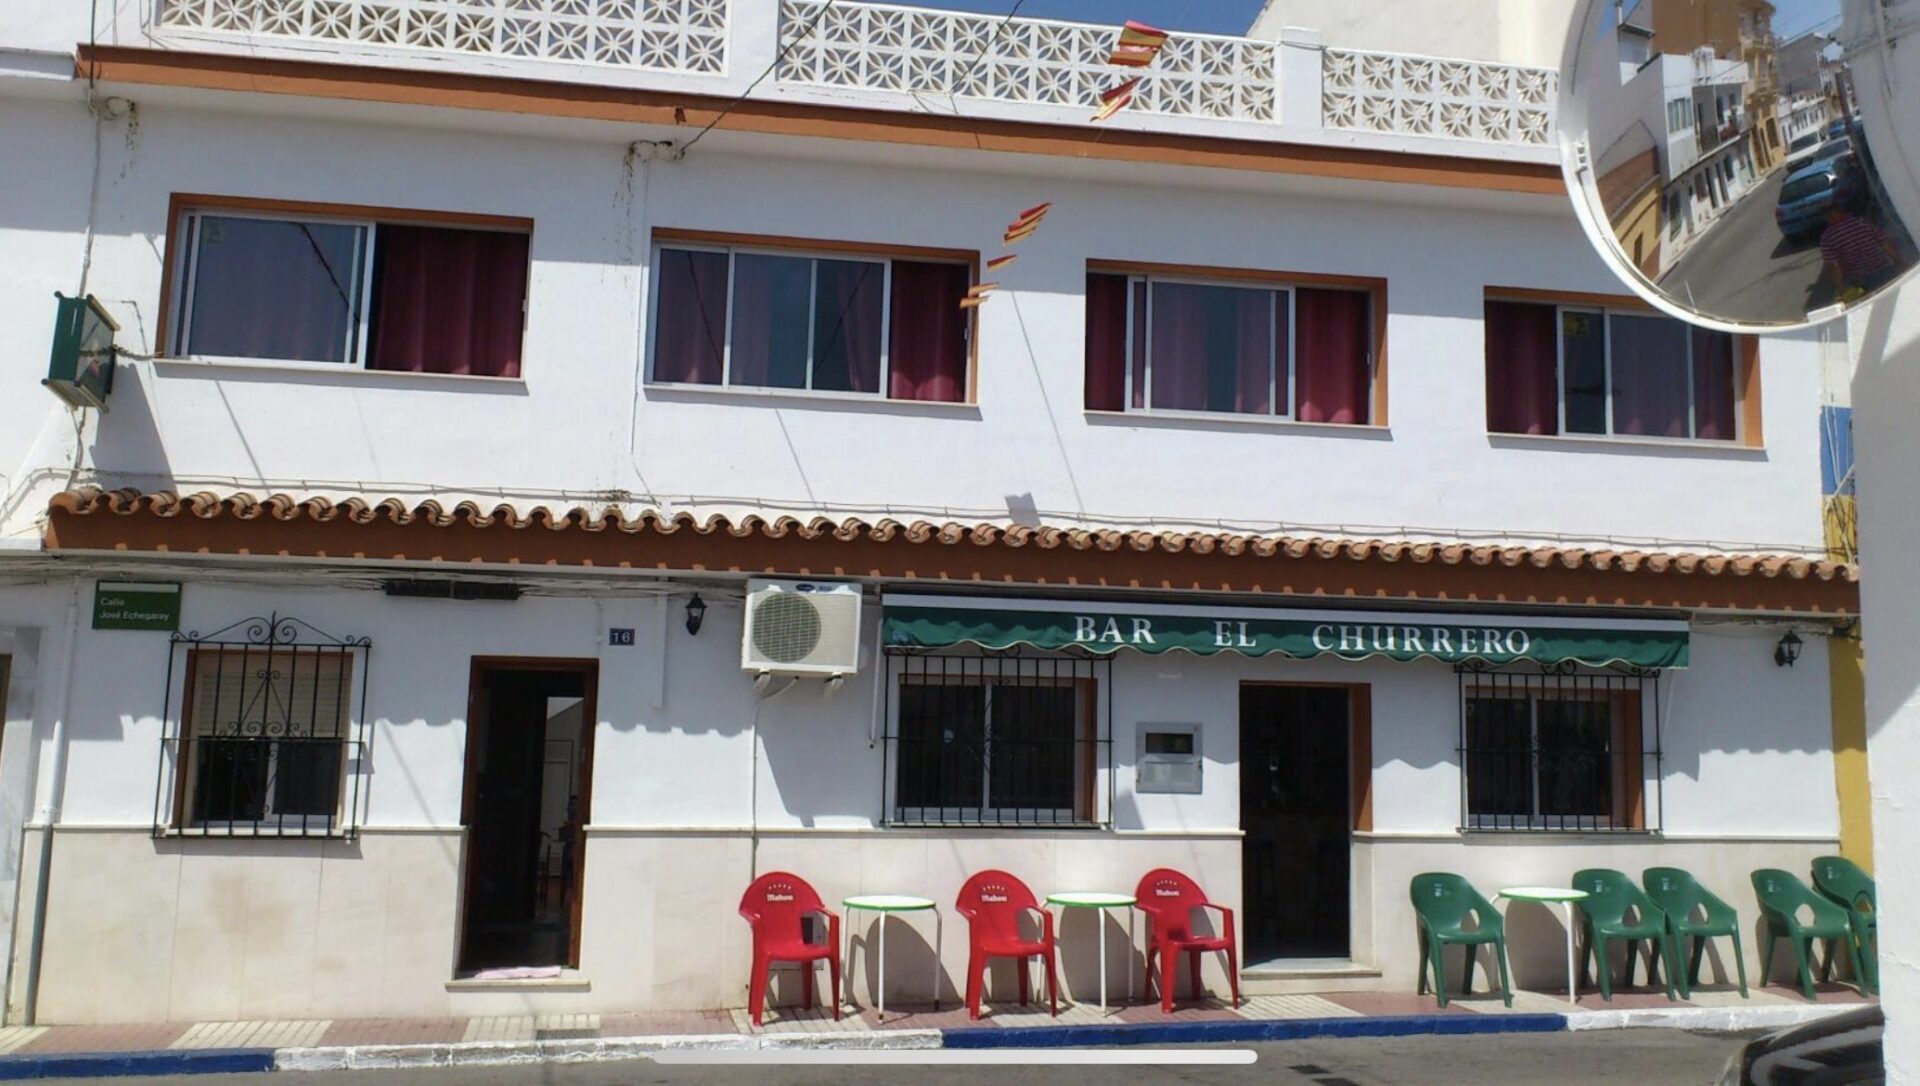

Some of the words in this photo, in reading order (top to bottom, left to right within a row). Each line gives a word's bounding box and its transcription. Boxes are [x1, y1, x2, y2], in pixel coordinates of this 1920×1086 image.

[100, 597, 126, 606] Calle
[123, 611, 170, 622] Echegaray
[612, 632, 630, 643] 16
[1074, 616, 1156, 643] BAR
[1213, 620, 1257, 647] EL
[1312, 624, 1530, 656] CHURRERO
